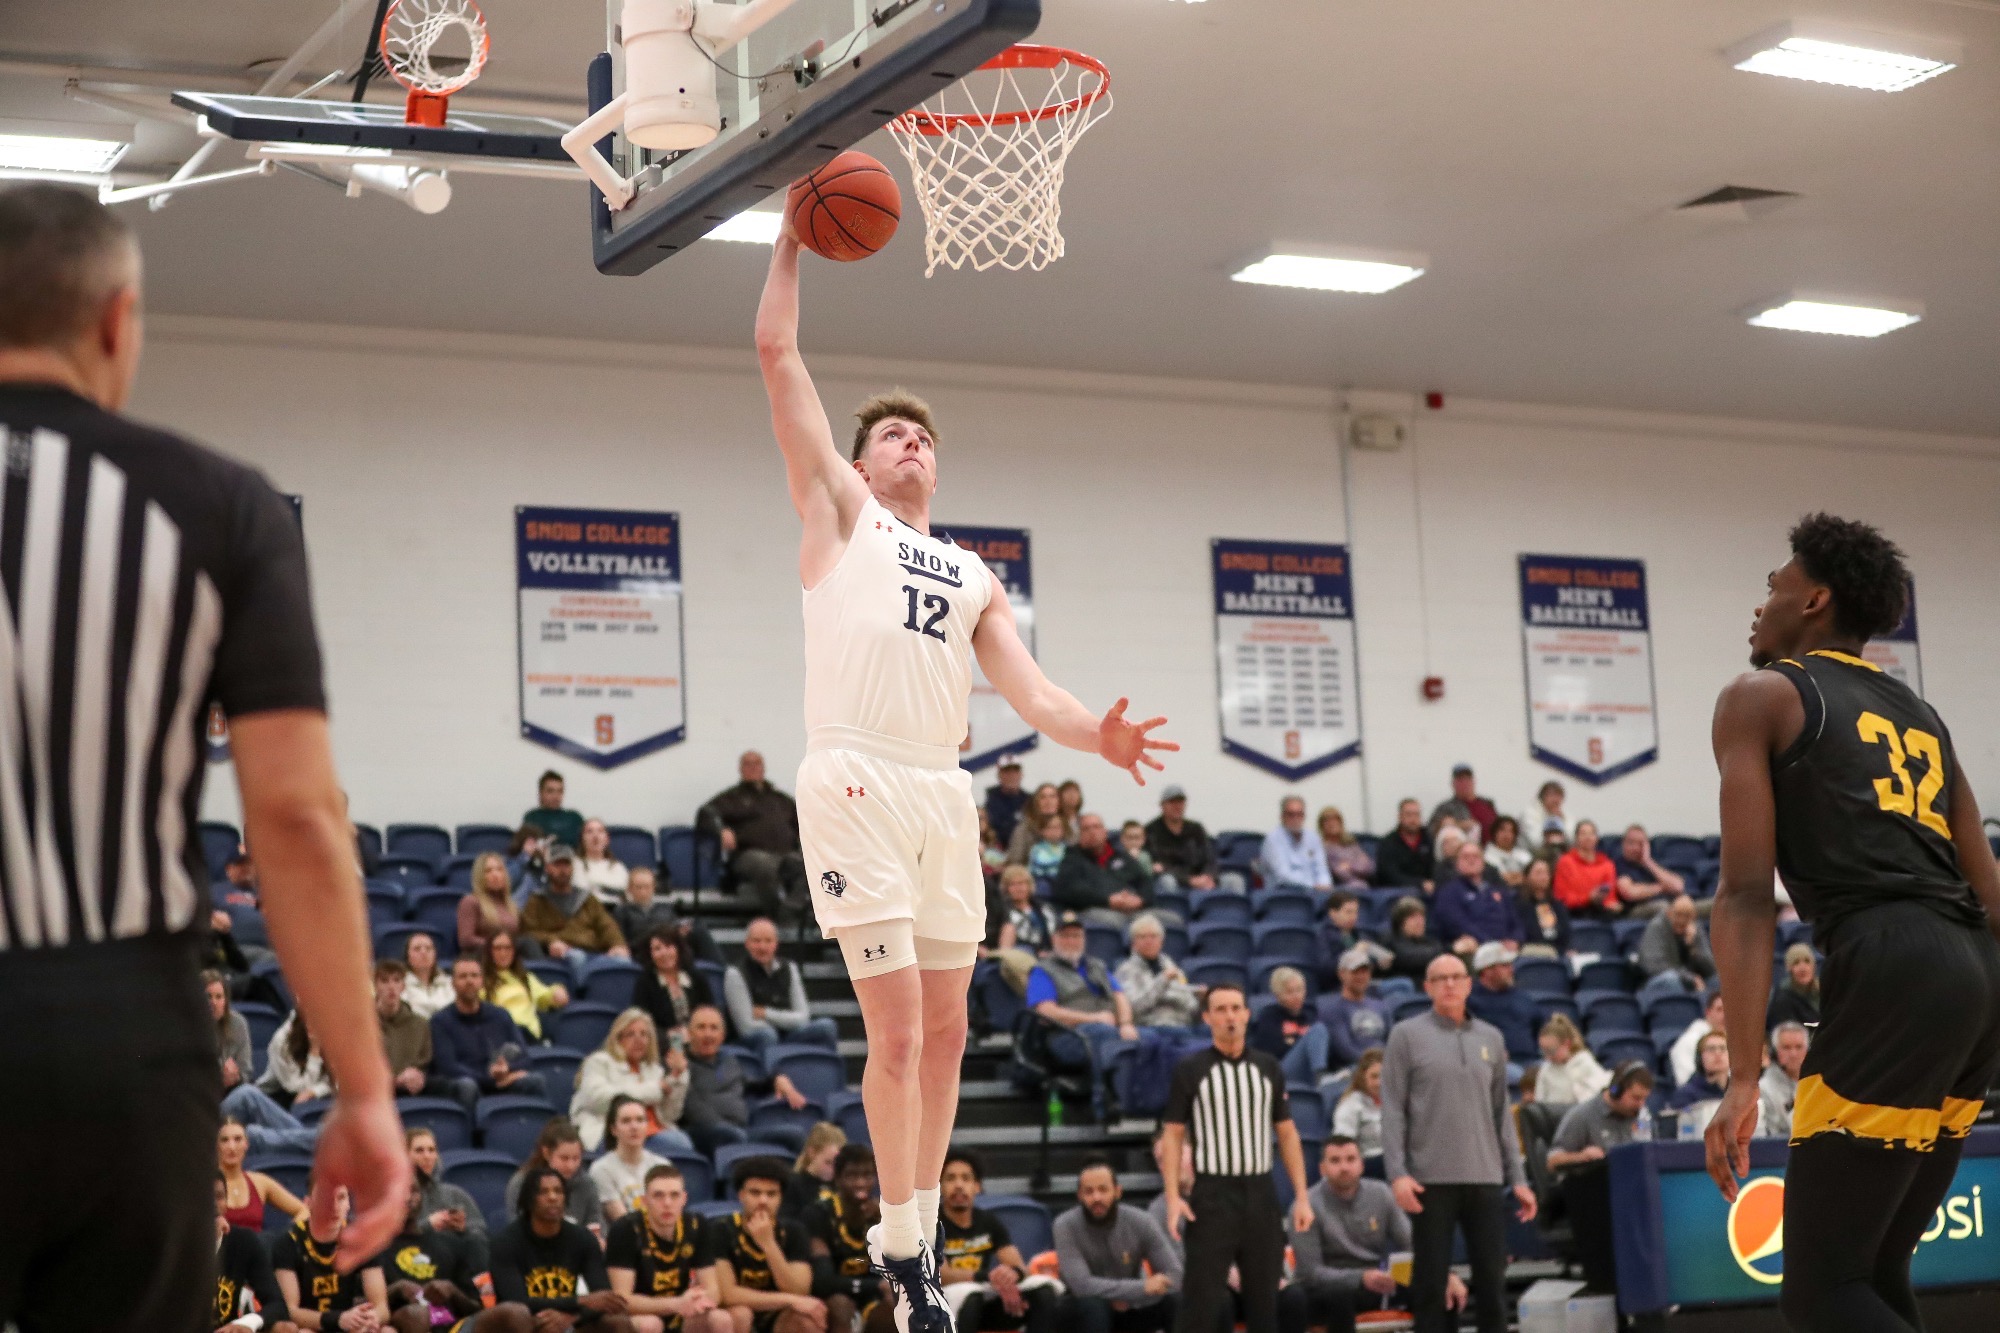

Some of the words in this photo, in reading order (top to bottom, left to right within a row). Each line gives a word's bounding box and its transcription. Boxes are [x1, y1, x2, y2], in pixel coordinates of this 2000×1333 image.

[526, 521, 582, 541] SNOW
[586, 523, 670, 545] COLLEGE
[527, 551, 671, 576] VOLLEYBALL
[898, 542, 961, 580] SNOW
[1254, 573, 1314, 594] MEN'S
[1223, 591, 1346, 615] BASKETBALL
[1557, 587, 1614, 607] MEN'S
[902, 585, 949, 643] 12
[1530, 603, 1643, 627] BASKETBALL
[595, 714, 615, 745] S
[1856, 711, 1951, 839] 32
